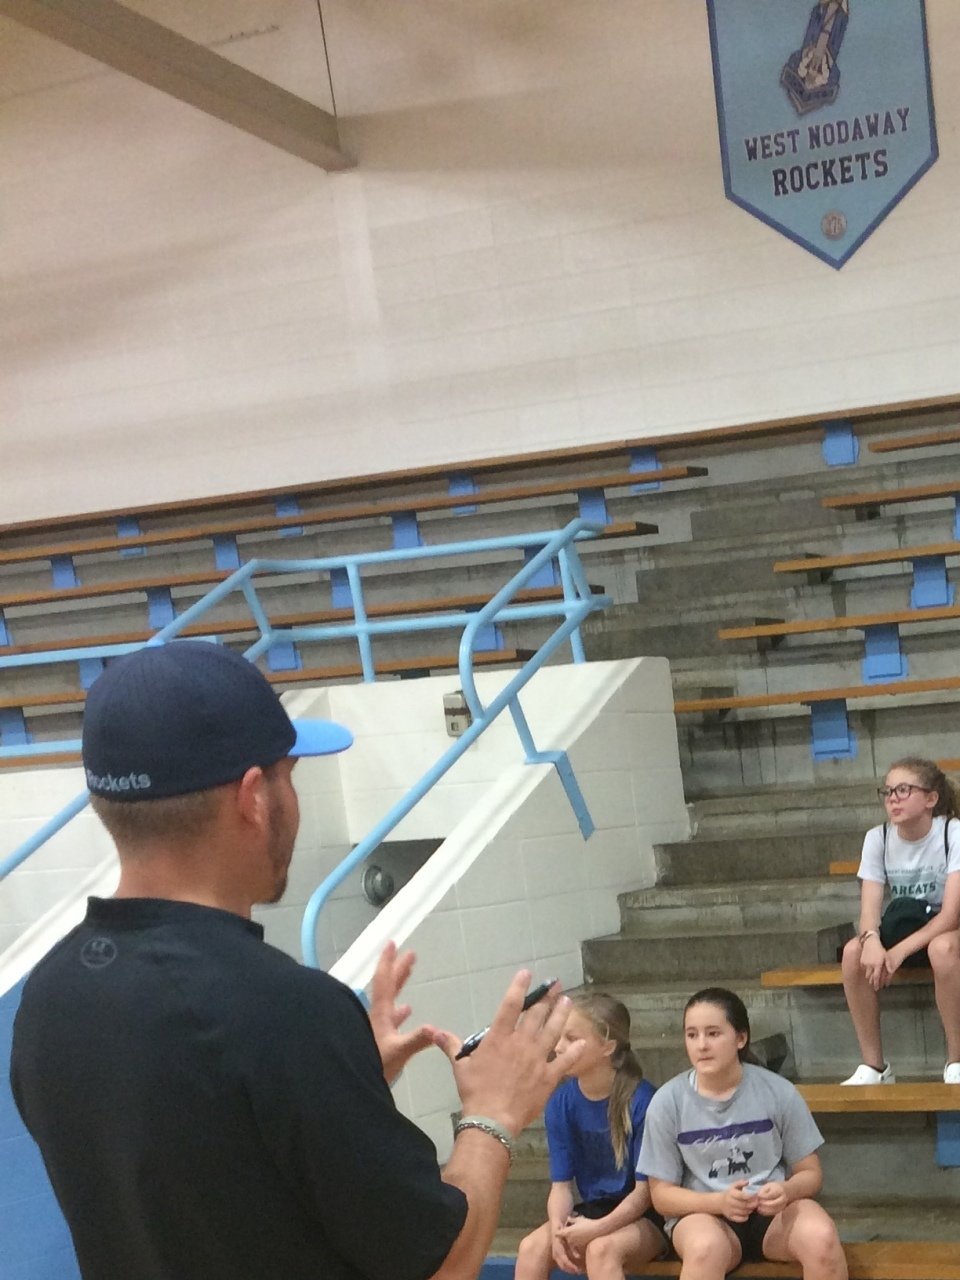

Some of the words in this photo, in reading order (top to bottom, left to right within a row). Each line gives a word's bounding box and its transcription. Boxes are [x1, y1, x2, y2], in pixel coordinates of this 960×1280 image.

[744, 129, 800, 161] WEST
[808, 107, 909, 150] NODAWAY
[773, 149, 889, 196] ROCKETS
